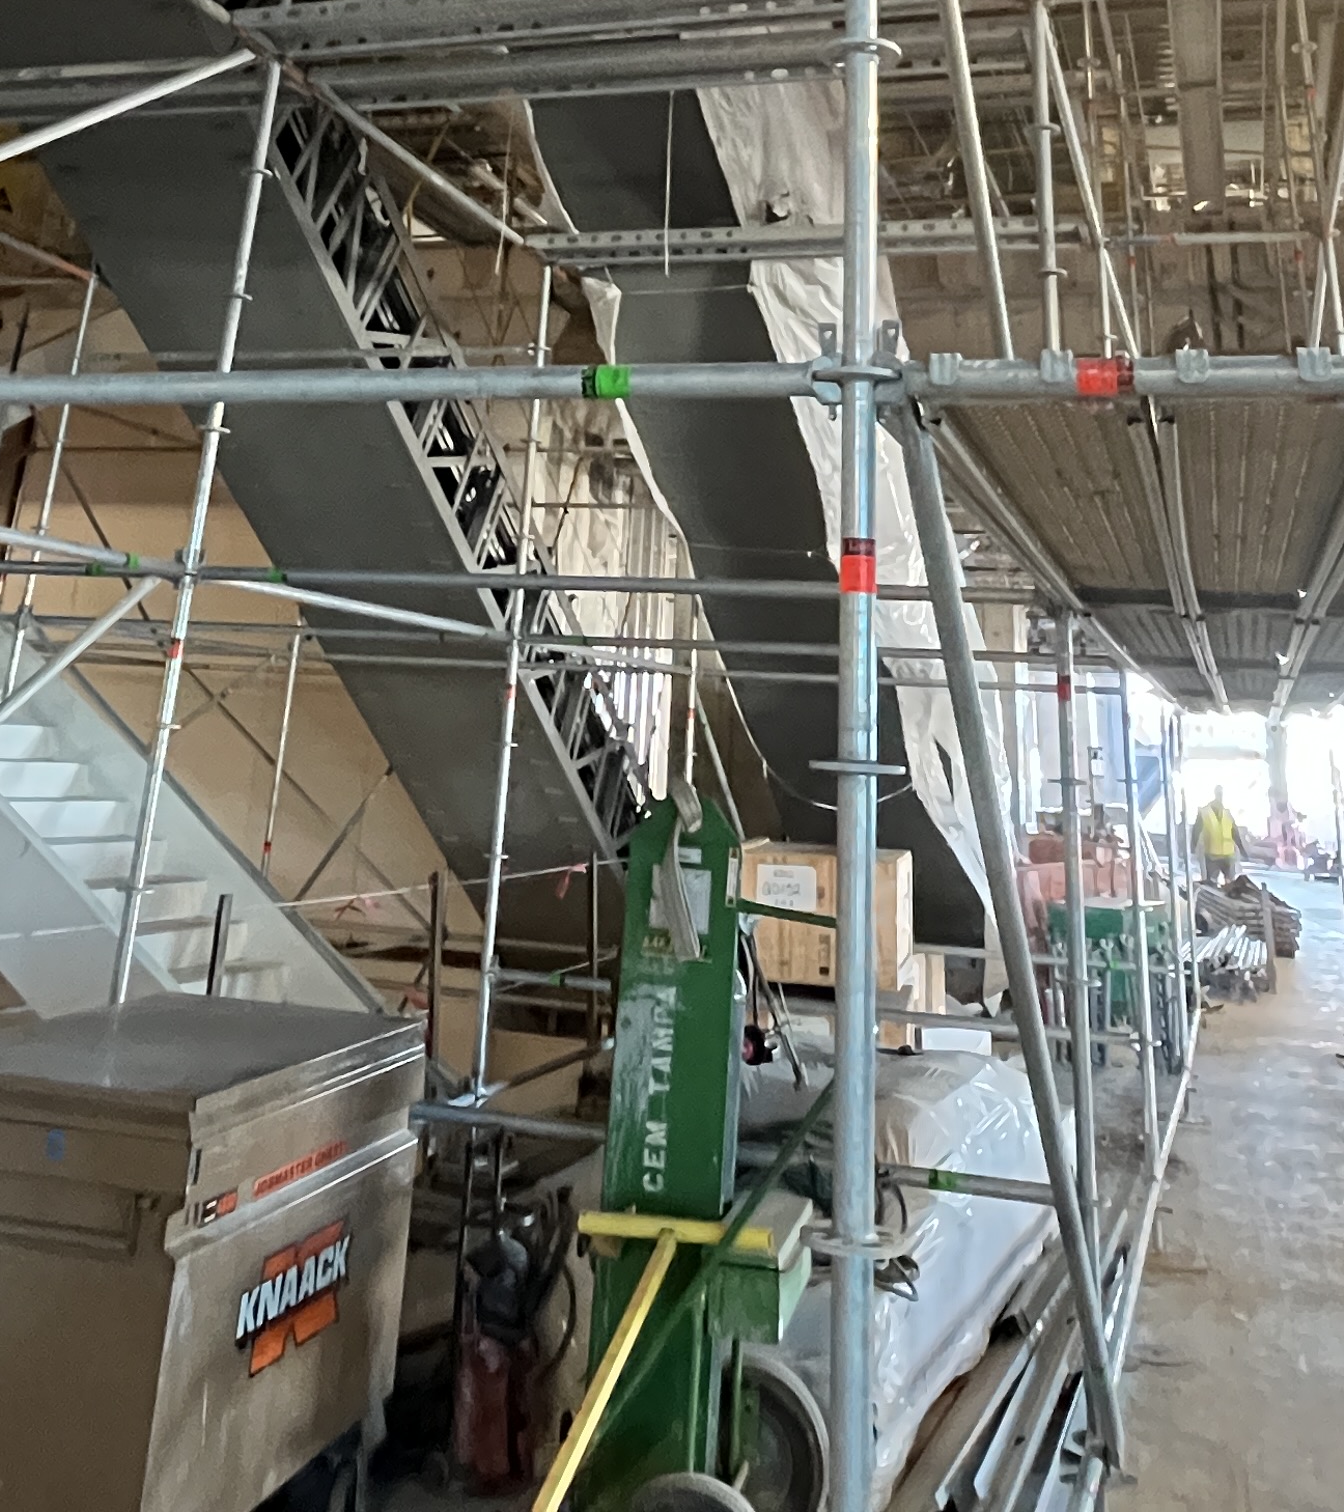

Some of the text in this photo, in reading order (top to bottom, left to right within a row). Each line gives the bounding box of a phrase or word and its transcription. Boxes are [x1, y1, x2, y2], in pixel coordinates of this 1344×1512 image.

[643, 986, 677, 1193] CEM TAMPA
[235, 1233, 351, 1341] KNAACK
